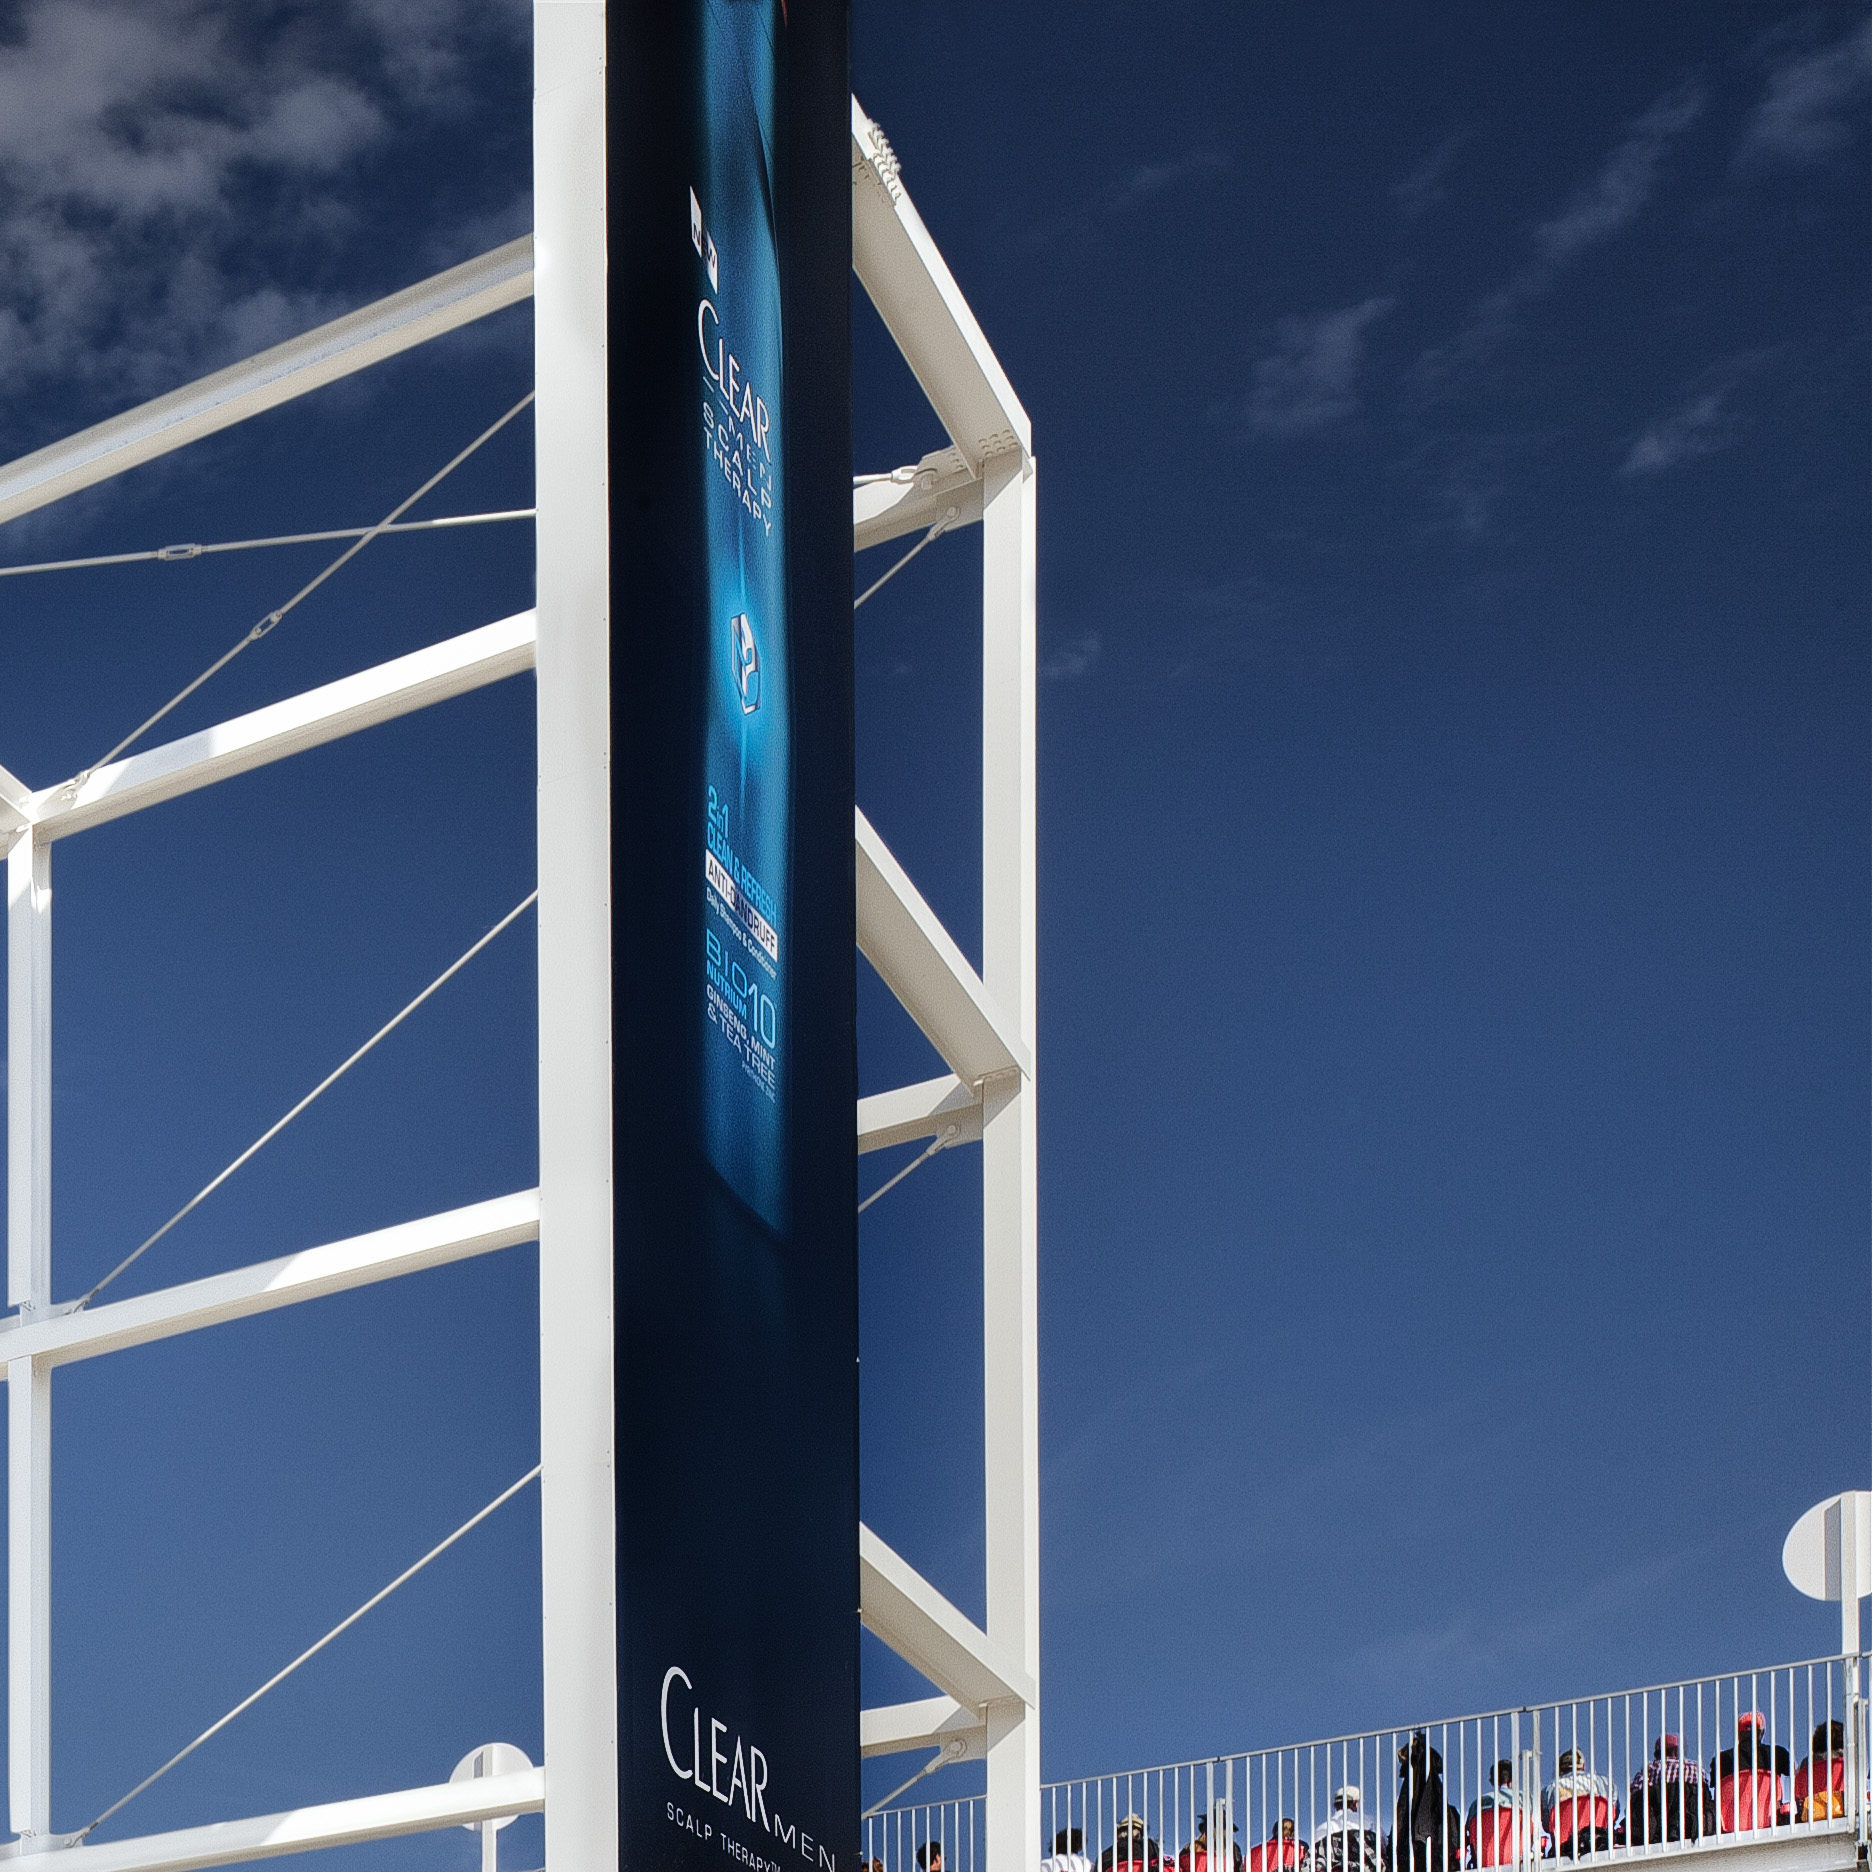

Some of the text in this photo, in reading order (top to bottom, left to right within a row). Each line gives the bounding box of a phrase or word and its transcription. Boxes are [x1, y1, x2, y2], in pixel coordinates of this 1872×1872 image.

[698, 299, 771, 463] CLEAR
[703, 402, 772, 508] SCALP
[704, 427, 772, 536] THERAPY
[707, 821, 777, 931] CLEAN & REFRESH
[708, 859, 776, 953] ANTI-DANDRUFF
[707, 959, 747, 1020] NUTRIUM
[707, 1002, 717, 1024] &
[719, 1013, 742, 1053] TEA
[744, 1044, 776, 1089] TREE
[751, 1035, 776, 1070] MINT
[661, 1666, 770, 1832] CLEAR
[667, 1802, 712, 1841] SCALP
